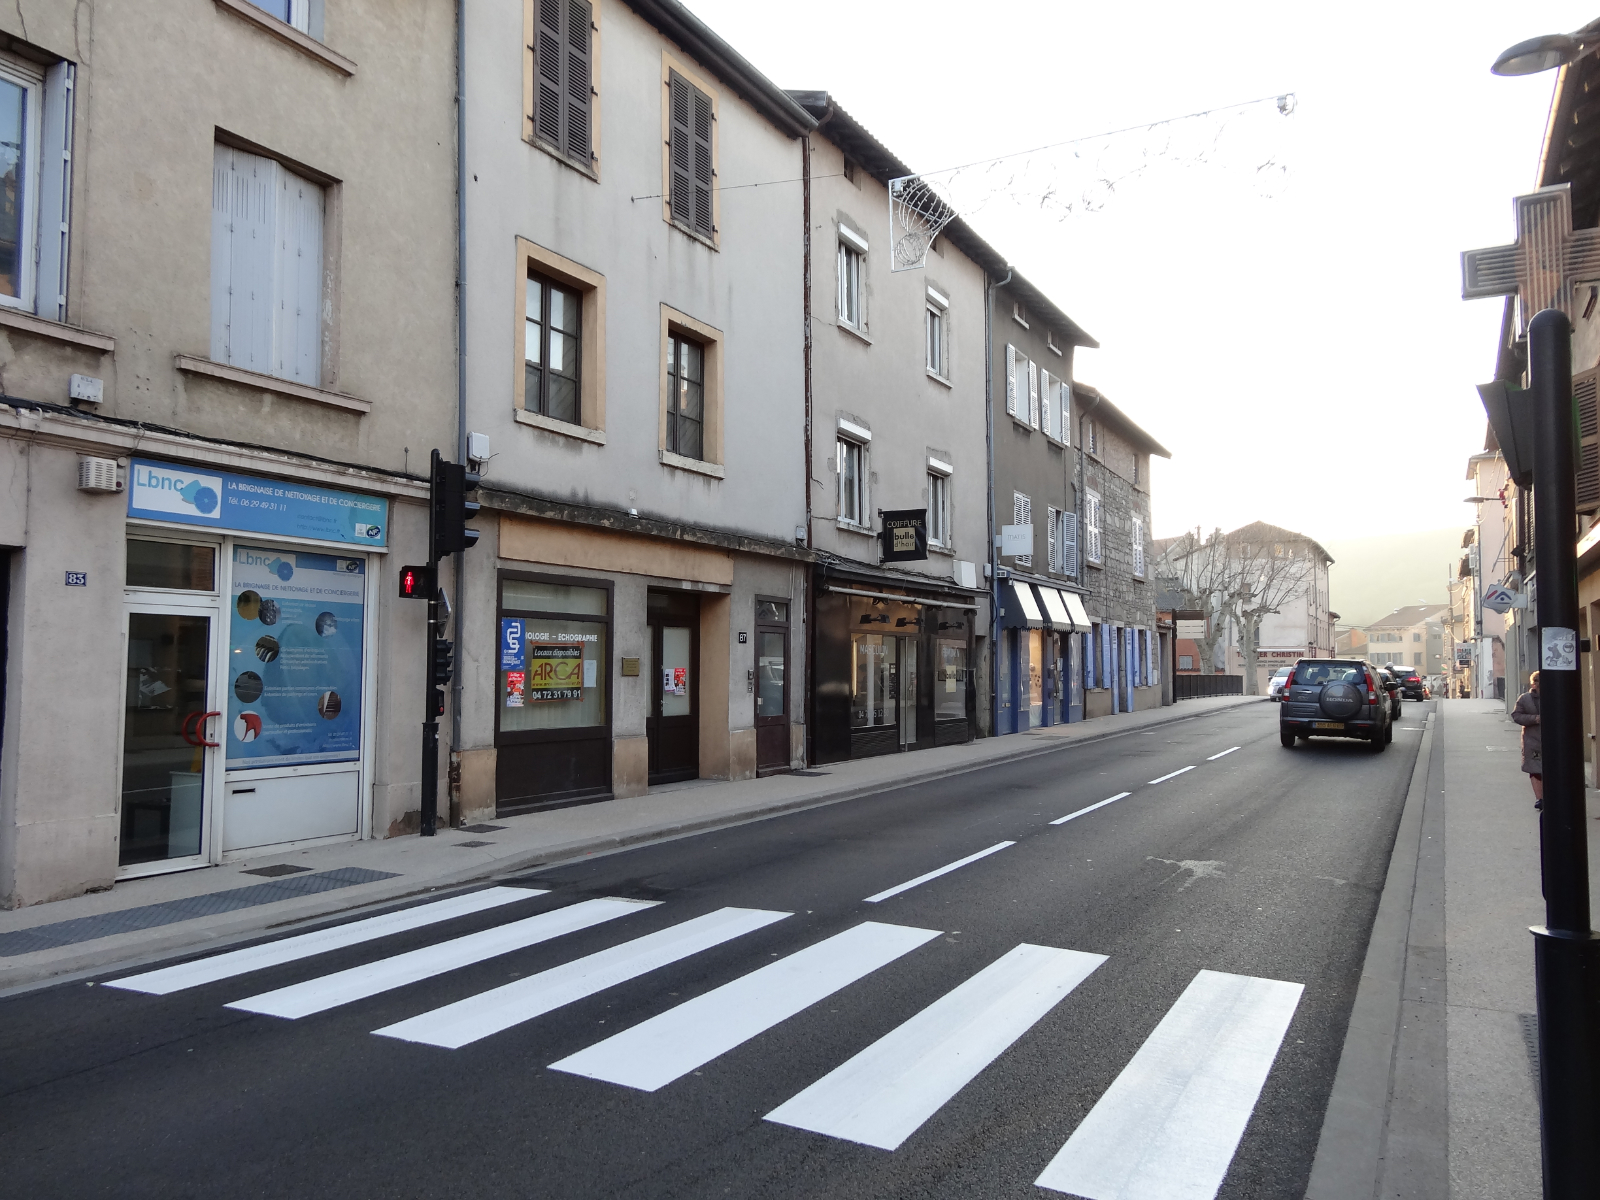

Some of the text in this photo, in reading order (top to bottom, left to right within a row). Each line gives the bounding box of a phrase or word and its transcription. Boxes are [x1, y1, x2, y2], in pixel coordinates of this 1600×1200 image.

[137, 468, 184, 492] Lbnc
[228, 481, 381, 512] LA BRIGNAISE DE NETTOYAGE ET DE CONCIERGERIE
[228, 496, 287, 512] Tél. 06 29 49 31 11
[886, 519, 922, 528] COIFFURE
[894, 531, 915, 541] bulle
[894, 540, 915, 548] d'hair
[238, 551, 271, 567] Lbnc
[68, 573, 85, 584] 83
[242, 582, 271, 591] BRIGNAISE
[280, 585, 309, 593] NETTOYAGE
[323, 588, 360, 597] CONCIERGERIE
[525, 631, 550, 641] IOLOGIE
[739, 633, 747, 642] 87
[534, 648, 581, 657] Locaux disponibles
[532, 661, 581, 681] ARCA
[532, 690, 542, 700] 04
[543, 690, 552, 699] 72
[553, 690, 561, 699] 31
[563, 689, 572, 698] 79
[573, 689, 581, 698] 91
